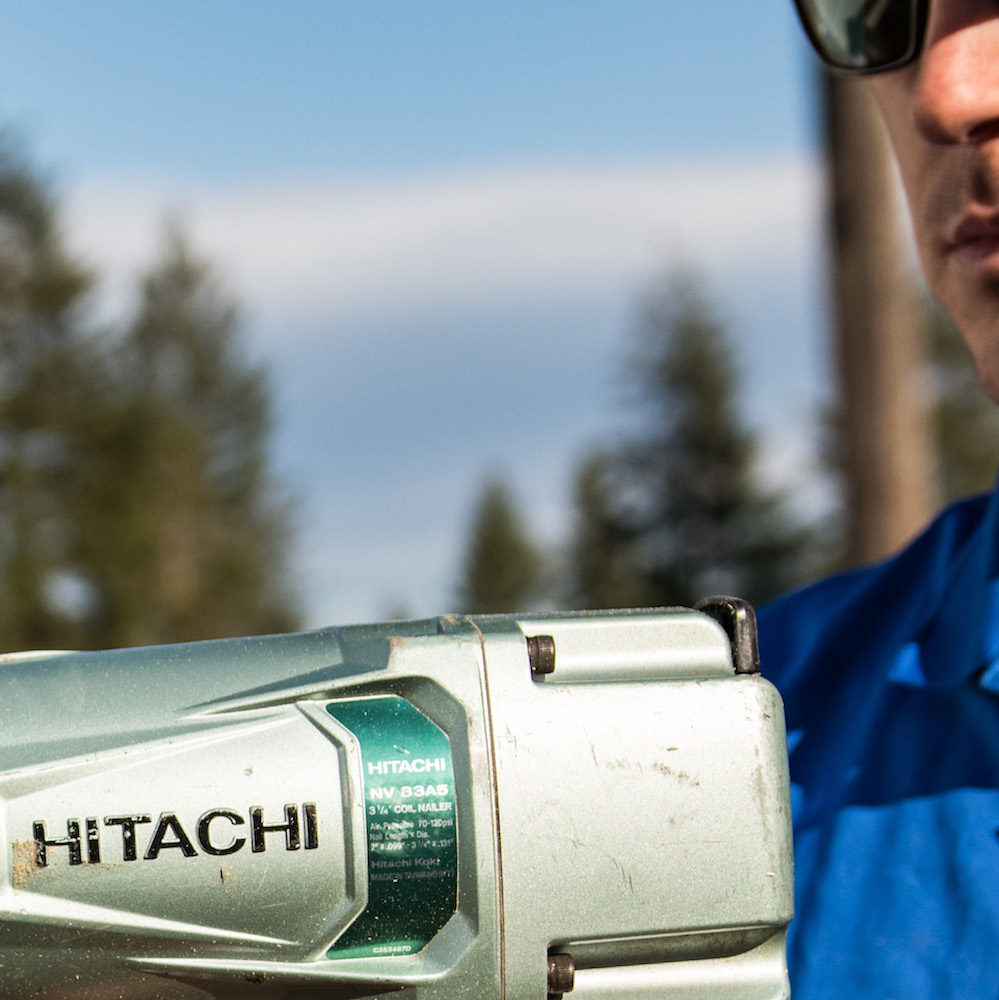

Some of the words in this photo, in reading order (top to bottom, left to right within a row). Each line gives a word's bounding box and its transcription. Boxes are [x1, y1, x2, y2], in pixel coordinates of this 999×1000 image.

[367, 757, 446, 775] HITACHI
[369, 787, 395, 800] NV
[400, 784, 450, 798] 83A5
[394, 804, 417, 814] COIL
[418, 802, 453, 812] NAILER
[32, 801, 319, 867] HITACHI
[371, 859, 412, 869] Hitachi
